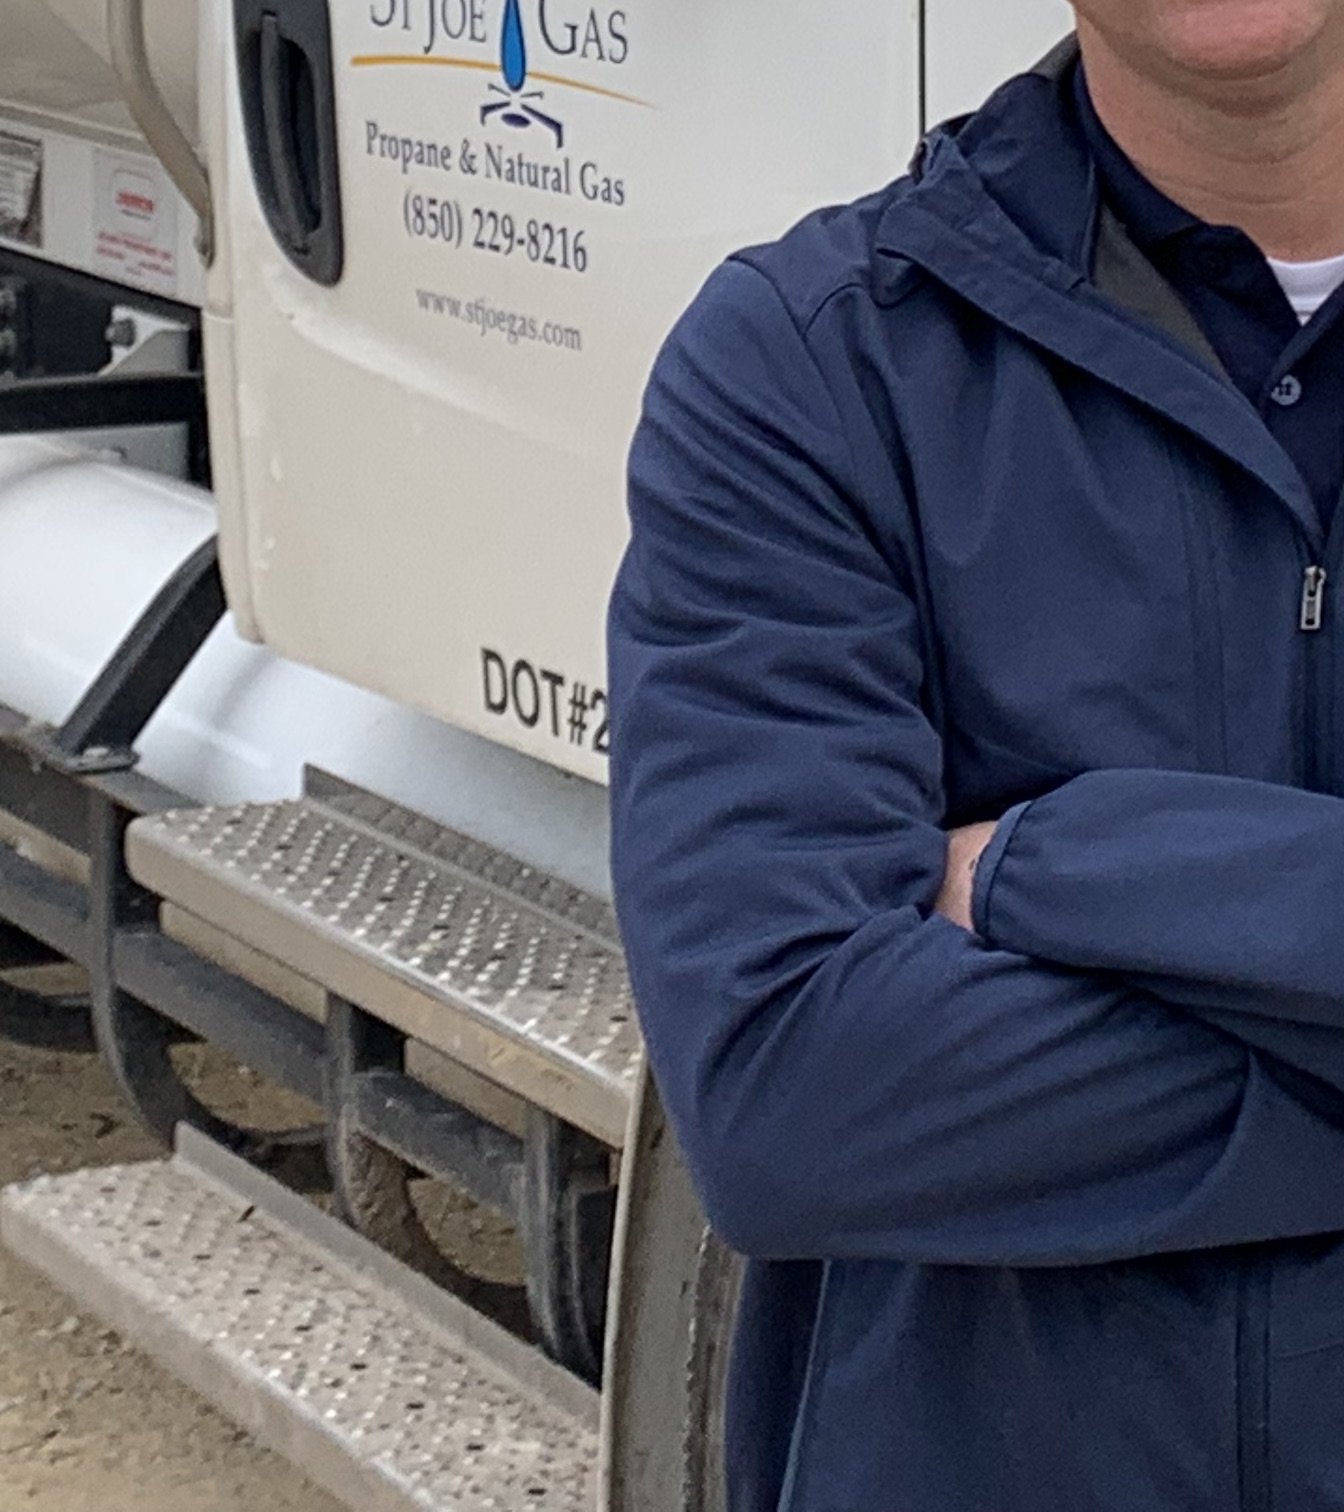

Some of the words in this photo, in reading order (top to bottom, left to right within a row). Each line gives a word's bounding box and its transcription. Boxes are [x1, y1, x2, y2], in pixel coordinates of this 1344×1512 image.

[365, 121, 452, 174] Propane
[459, 139, 477, 176] &
[484, 143, 570, 194] Natural
[579, 162, 625, 206] Gas
[403, 193, 463, 249] (850)
[472, 207, 587, 272] 229-8216
[415, 288, 583, 352] www.stjoegas.com
